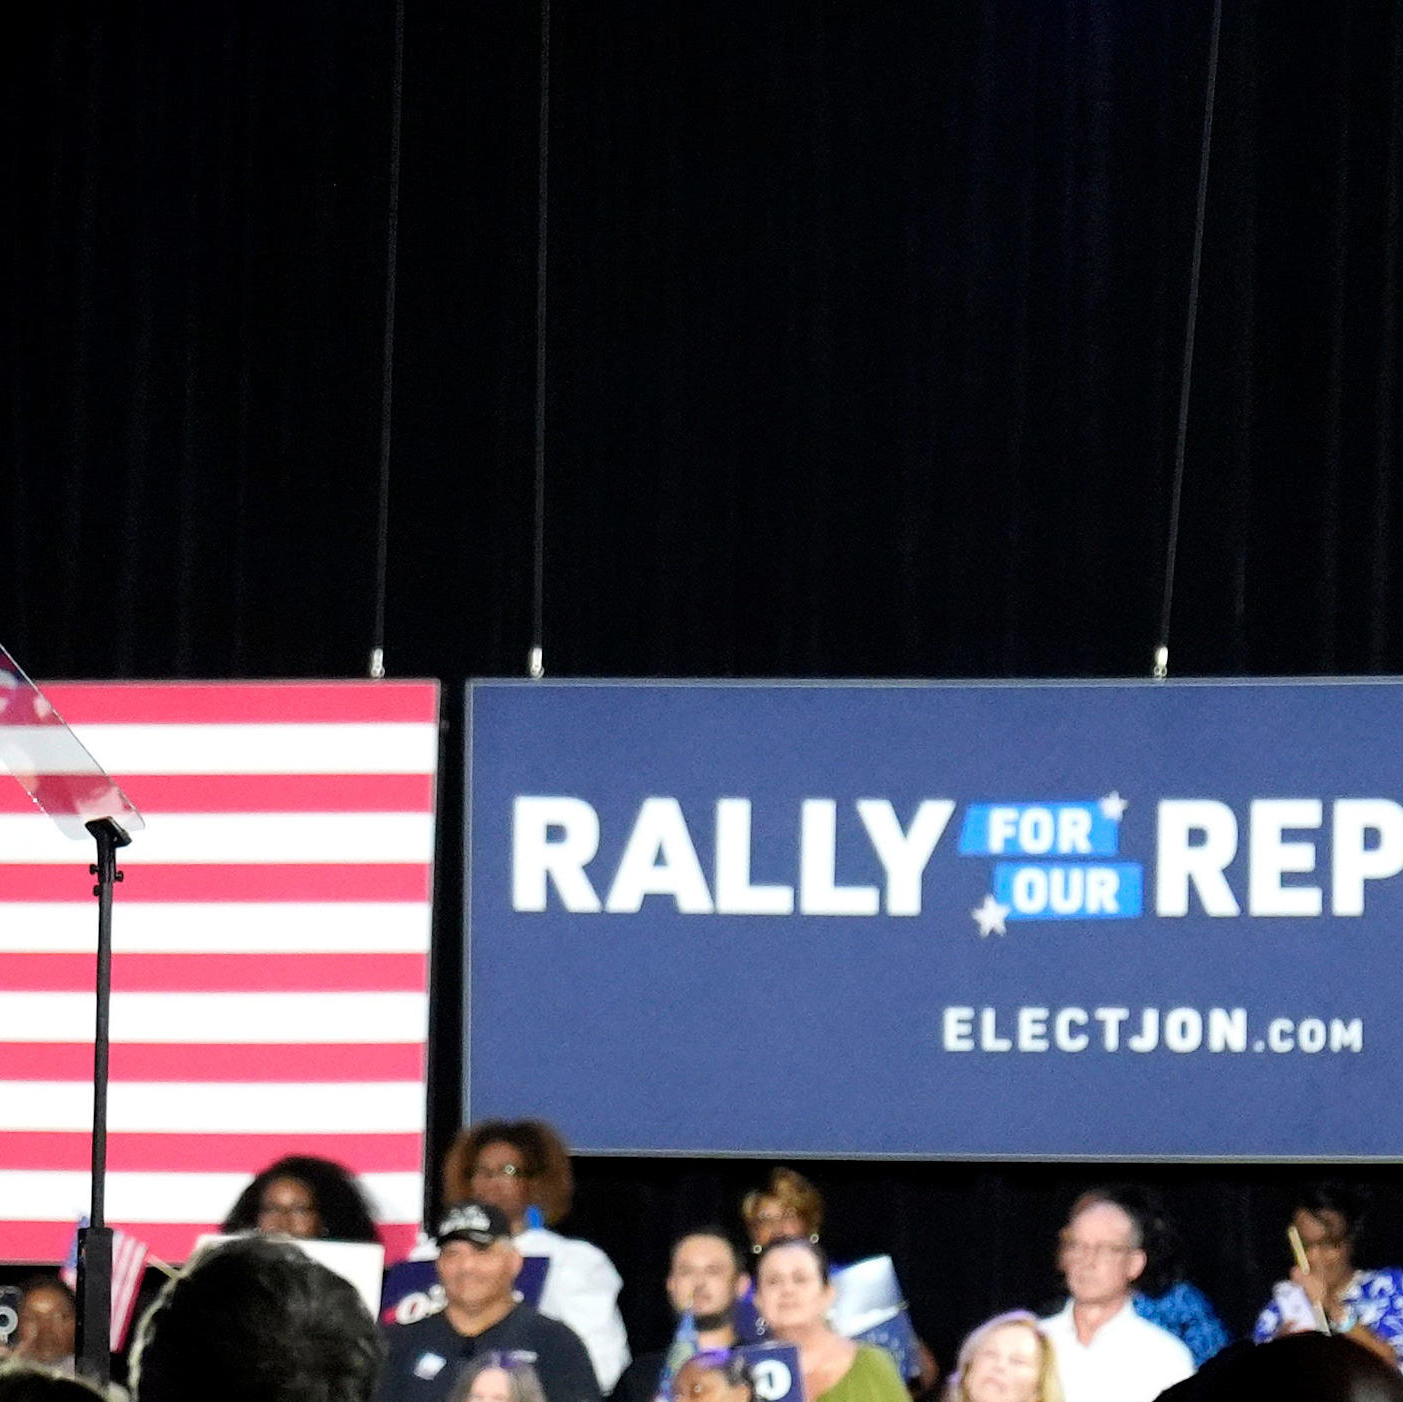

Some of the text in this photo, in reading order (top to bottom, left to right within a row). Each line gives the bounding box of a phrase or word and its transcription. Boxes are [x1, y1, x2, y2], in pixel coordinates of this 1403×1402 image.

[988, 807, 1093, 855] FOR
[511, 795, 957, 917] RALLY
[1012, 867, 1120, 915] OUR
[942, 1006, 1364, 1053] ELECTJON.COM
